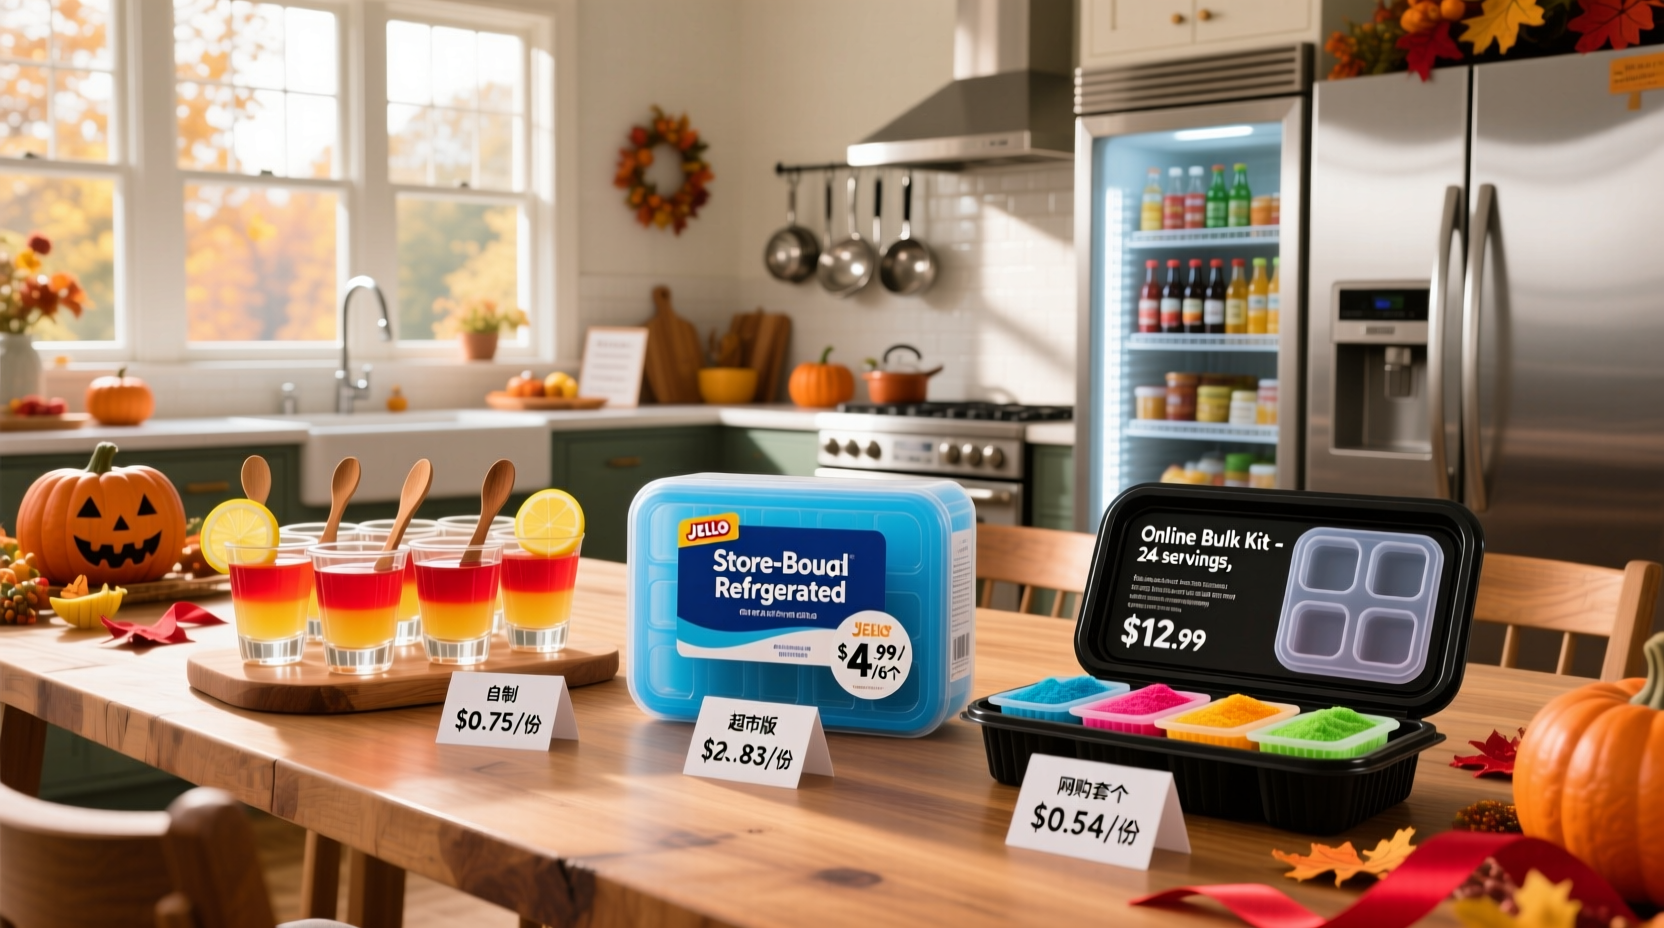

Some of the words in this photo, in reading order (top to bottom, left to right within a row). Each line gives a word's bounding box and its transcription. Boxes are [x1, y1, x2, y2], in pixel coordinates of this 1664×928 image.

[687, 520, 730, 541] JELLO
[1141, 525, 1197, 546] Online
[1201, 528, 1241, 548] Bulk
[1244, 531, 1272, 551] Kit
[1136, 546, 1159, 563] 24
[1161, 549, 1233, 573] servings,
[715, 576, 846, 606] Refrgerated
[1120, 613, 1207, 652] $12.99
[486, 684, 519, 704] 自制
[455, 707, 542, 735] $0.75/份
[727, 710, 778, 736] 超市版
[1030, 801, 1140, 845] $0.54/份
